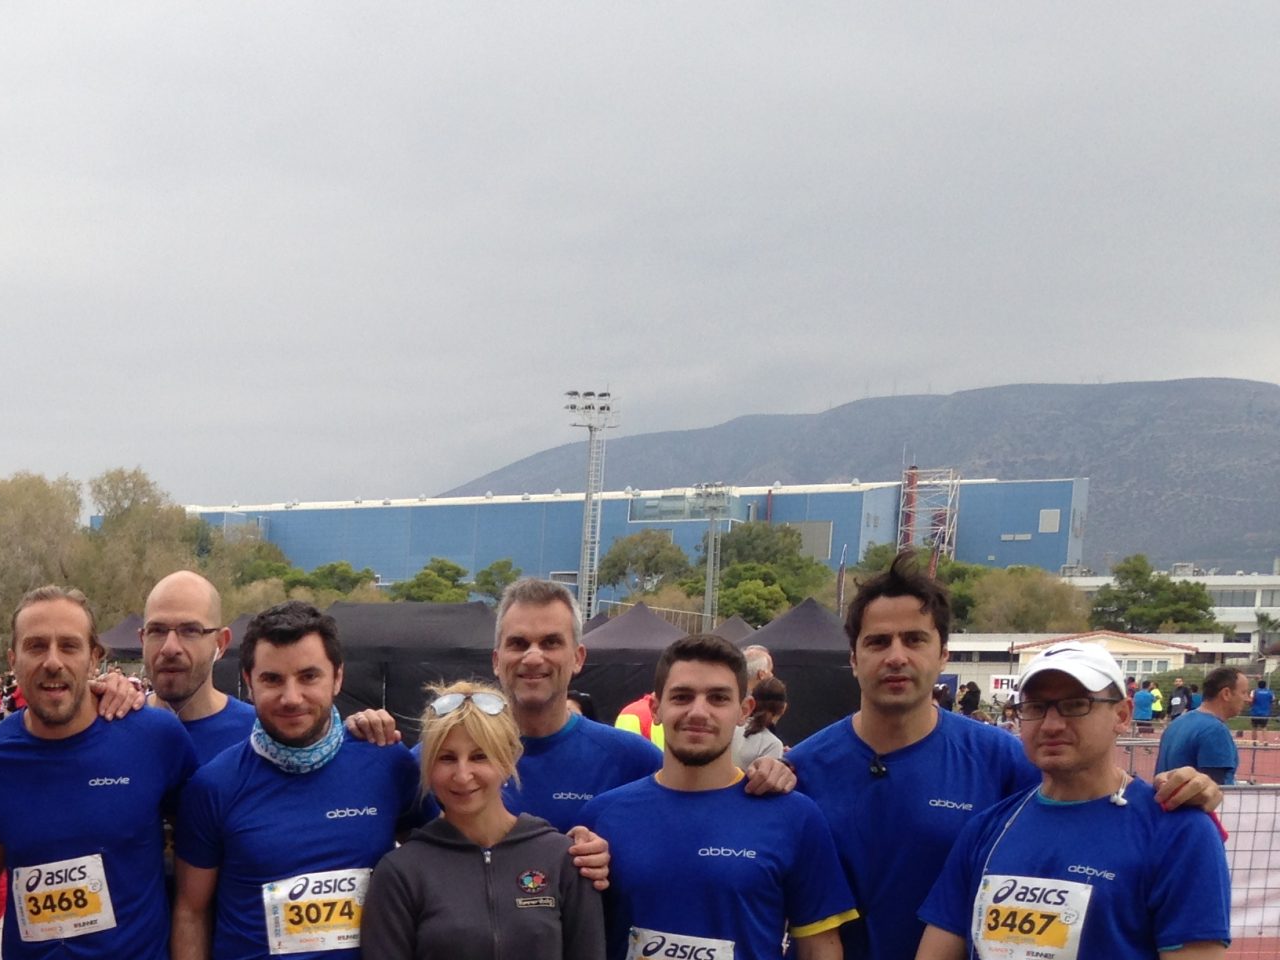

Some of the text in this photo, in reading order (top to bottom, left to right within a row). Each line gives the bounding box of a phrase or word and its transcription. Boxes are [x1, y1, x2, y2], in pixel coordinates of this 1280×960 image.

[89, 776, 130, 787] abbvie
[552, 791, 594, 801] abbvie
[929, 799, 973, 811] abbvie
[326, 806, 378, 819] abbvie
[698, 846, 757, 859] abbvie
[44, 864, 87, 886] asics
[1068, 864, 1116, 881] abbvie
[311, 876, 356, 895] asics
[27, 888, 89, 916] 3468
[1015, 886, 1069, 906] asics
[288, 900, 354, 926] 3074
[987, 908, 1057, 936] 3467
